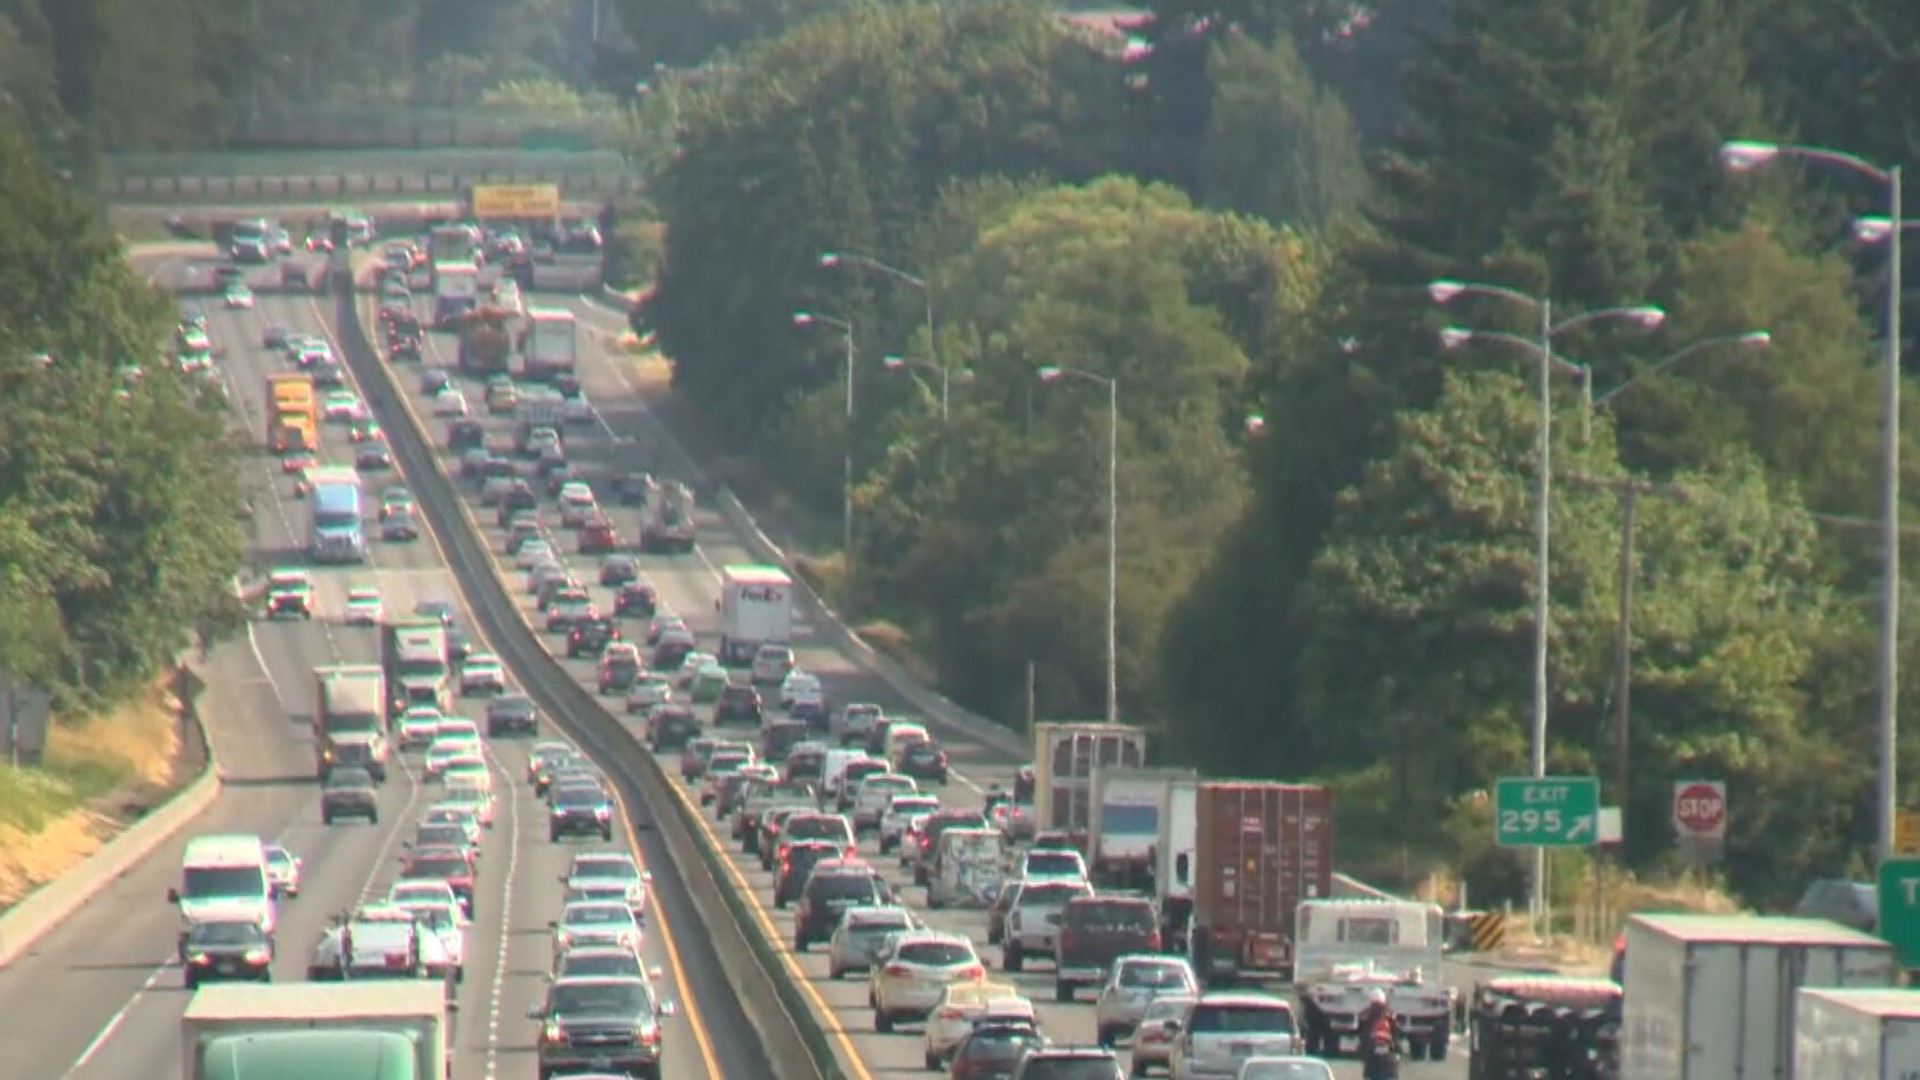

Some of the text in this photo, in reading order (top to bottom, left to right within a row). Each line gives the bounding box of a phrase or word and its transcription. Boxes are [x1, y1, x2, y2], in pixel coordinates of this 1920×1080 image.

[1523, 786, 1568, 803] EXIT
[1679, 798, 1722, 818] STOP
[1502, 808, 1562, 833] 295
